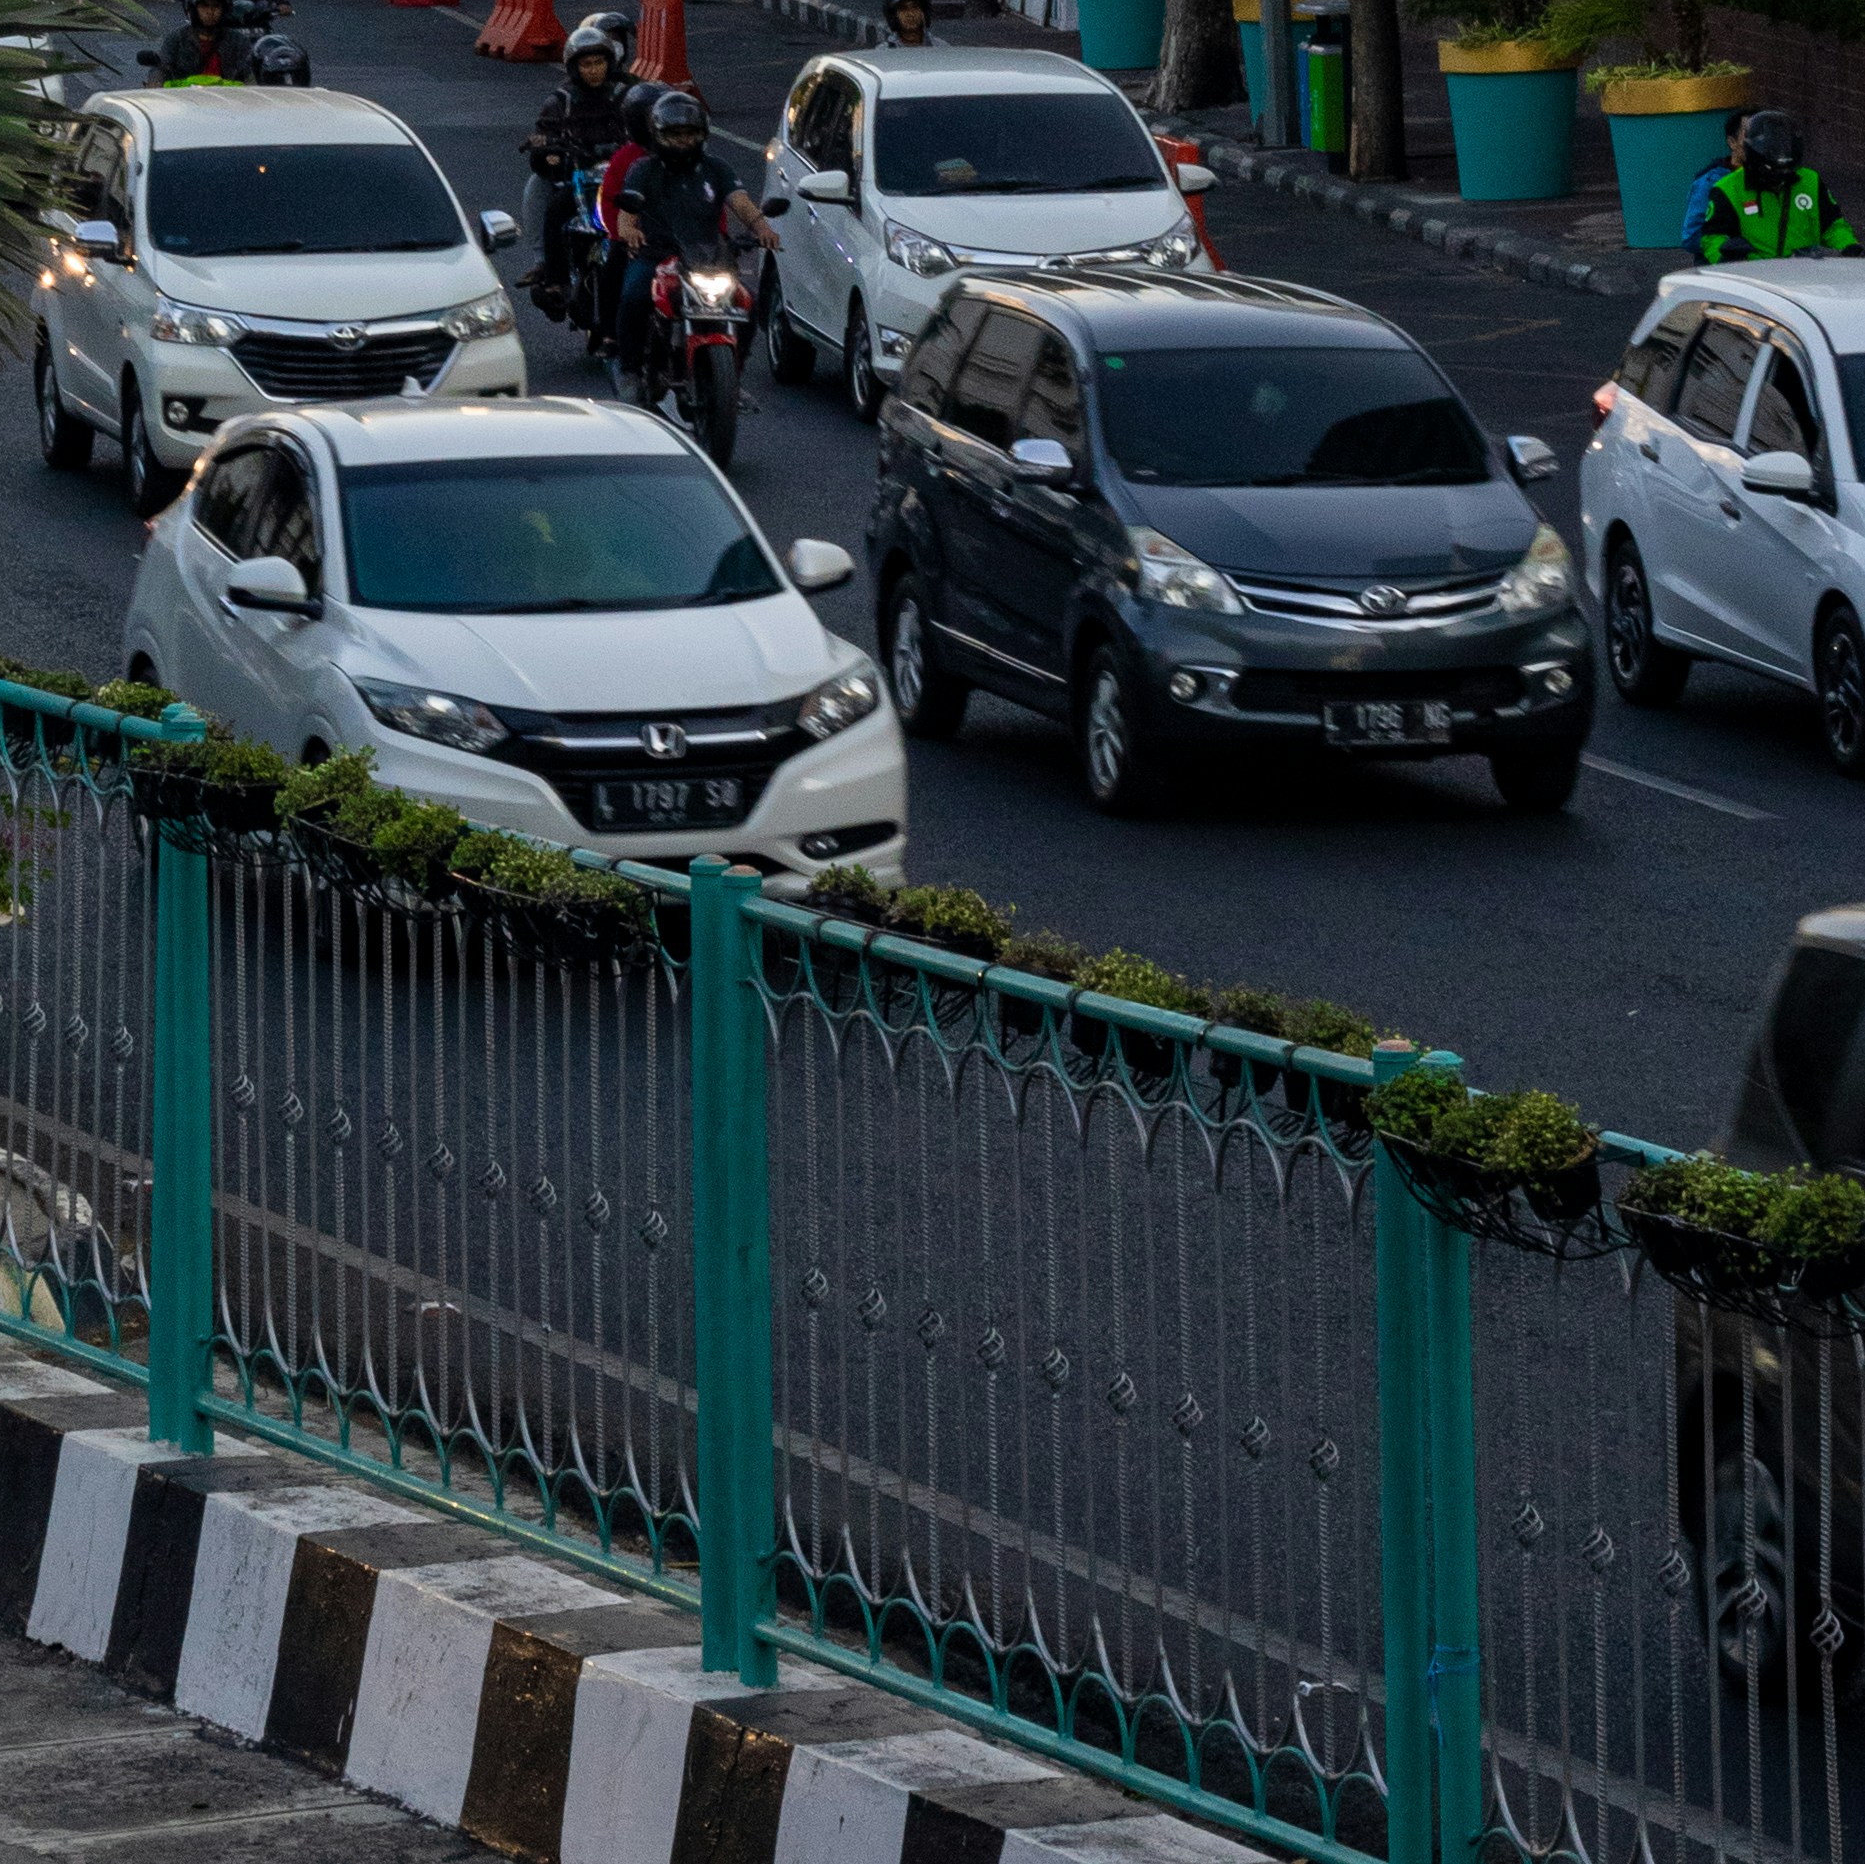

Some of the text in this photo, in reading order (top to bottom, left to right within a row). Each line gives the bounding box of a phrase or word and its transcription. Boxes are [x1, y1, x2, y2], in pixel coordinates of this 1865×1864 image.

[1323, 704, 1340, 731] L
[597, 784, 614, 815] L
[632, 782, 690, 811] 1797
